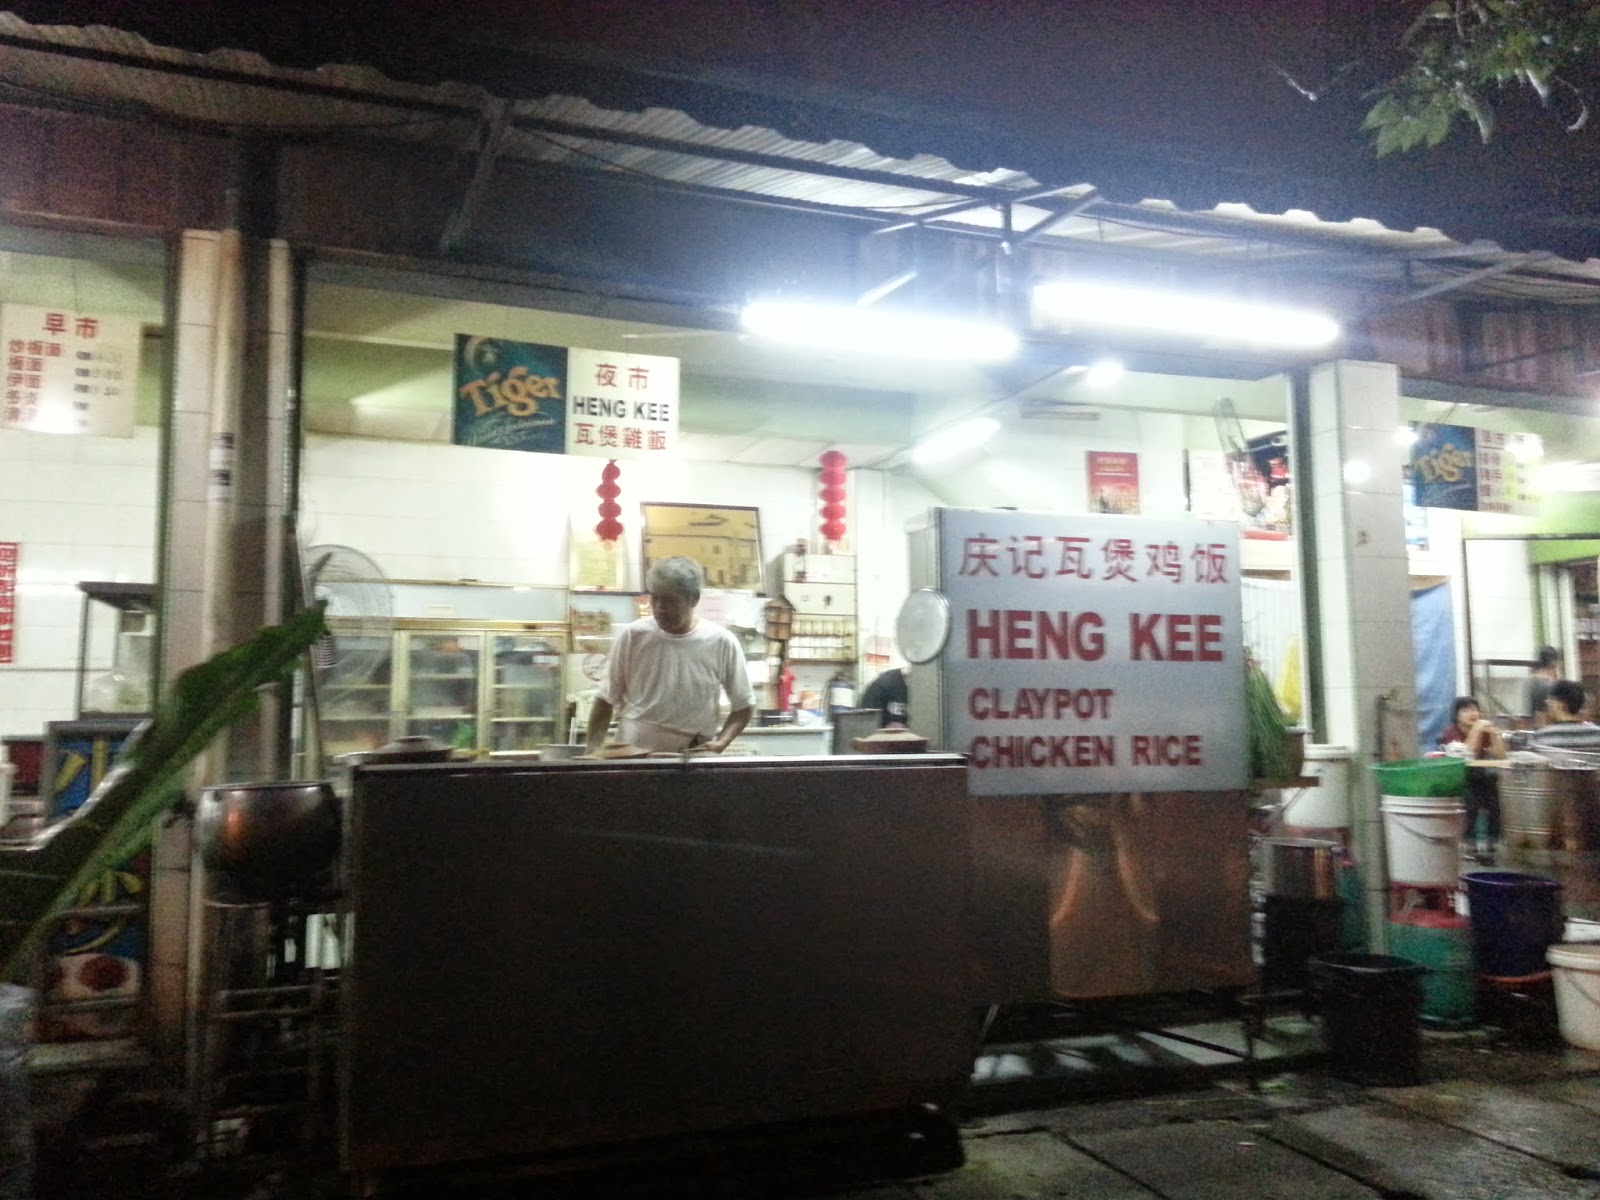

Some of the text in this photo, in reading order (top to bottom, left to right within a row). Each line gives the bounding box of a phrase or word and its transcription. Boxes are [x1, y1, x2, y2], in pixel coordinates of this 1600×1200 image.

[42, 312, 99, 339] 早市
[595, 362, 650, 391] 夜市
[572, 395, 670, 422] HENG KEE
[958, 532, 1231, 584] 庆记瓦煲鸡饭
[966, 608, 1225, 662] HENG KEE
[967, 687, 1114, 721] CLAYPOT
[968, 735, 1203, 769] CHICKEN RICE
